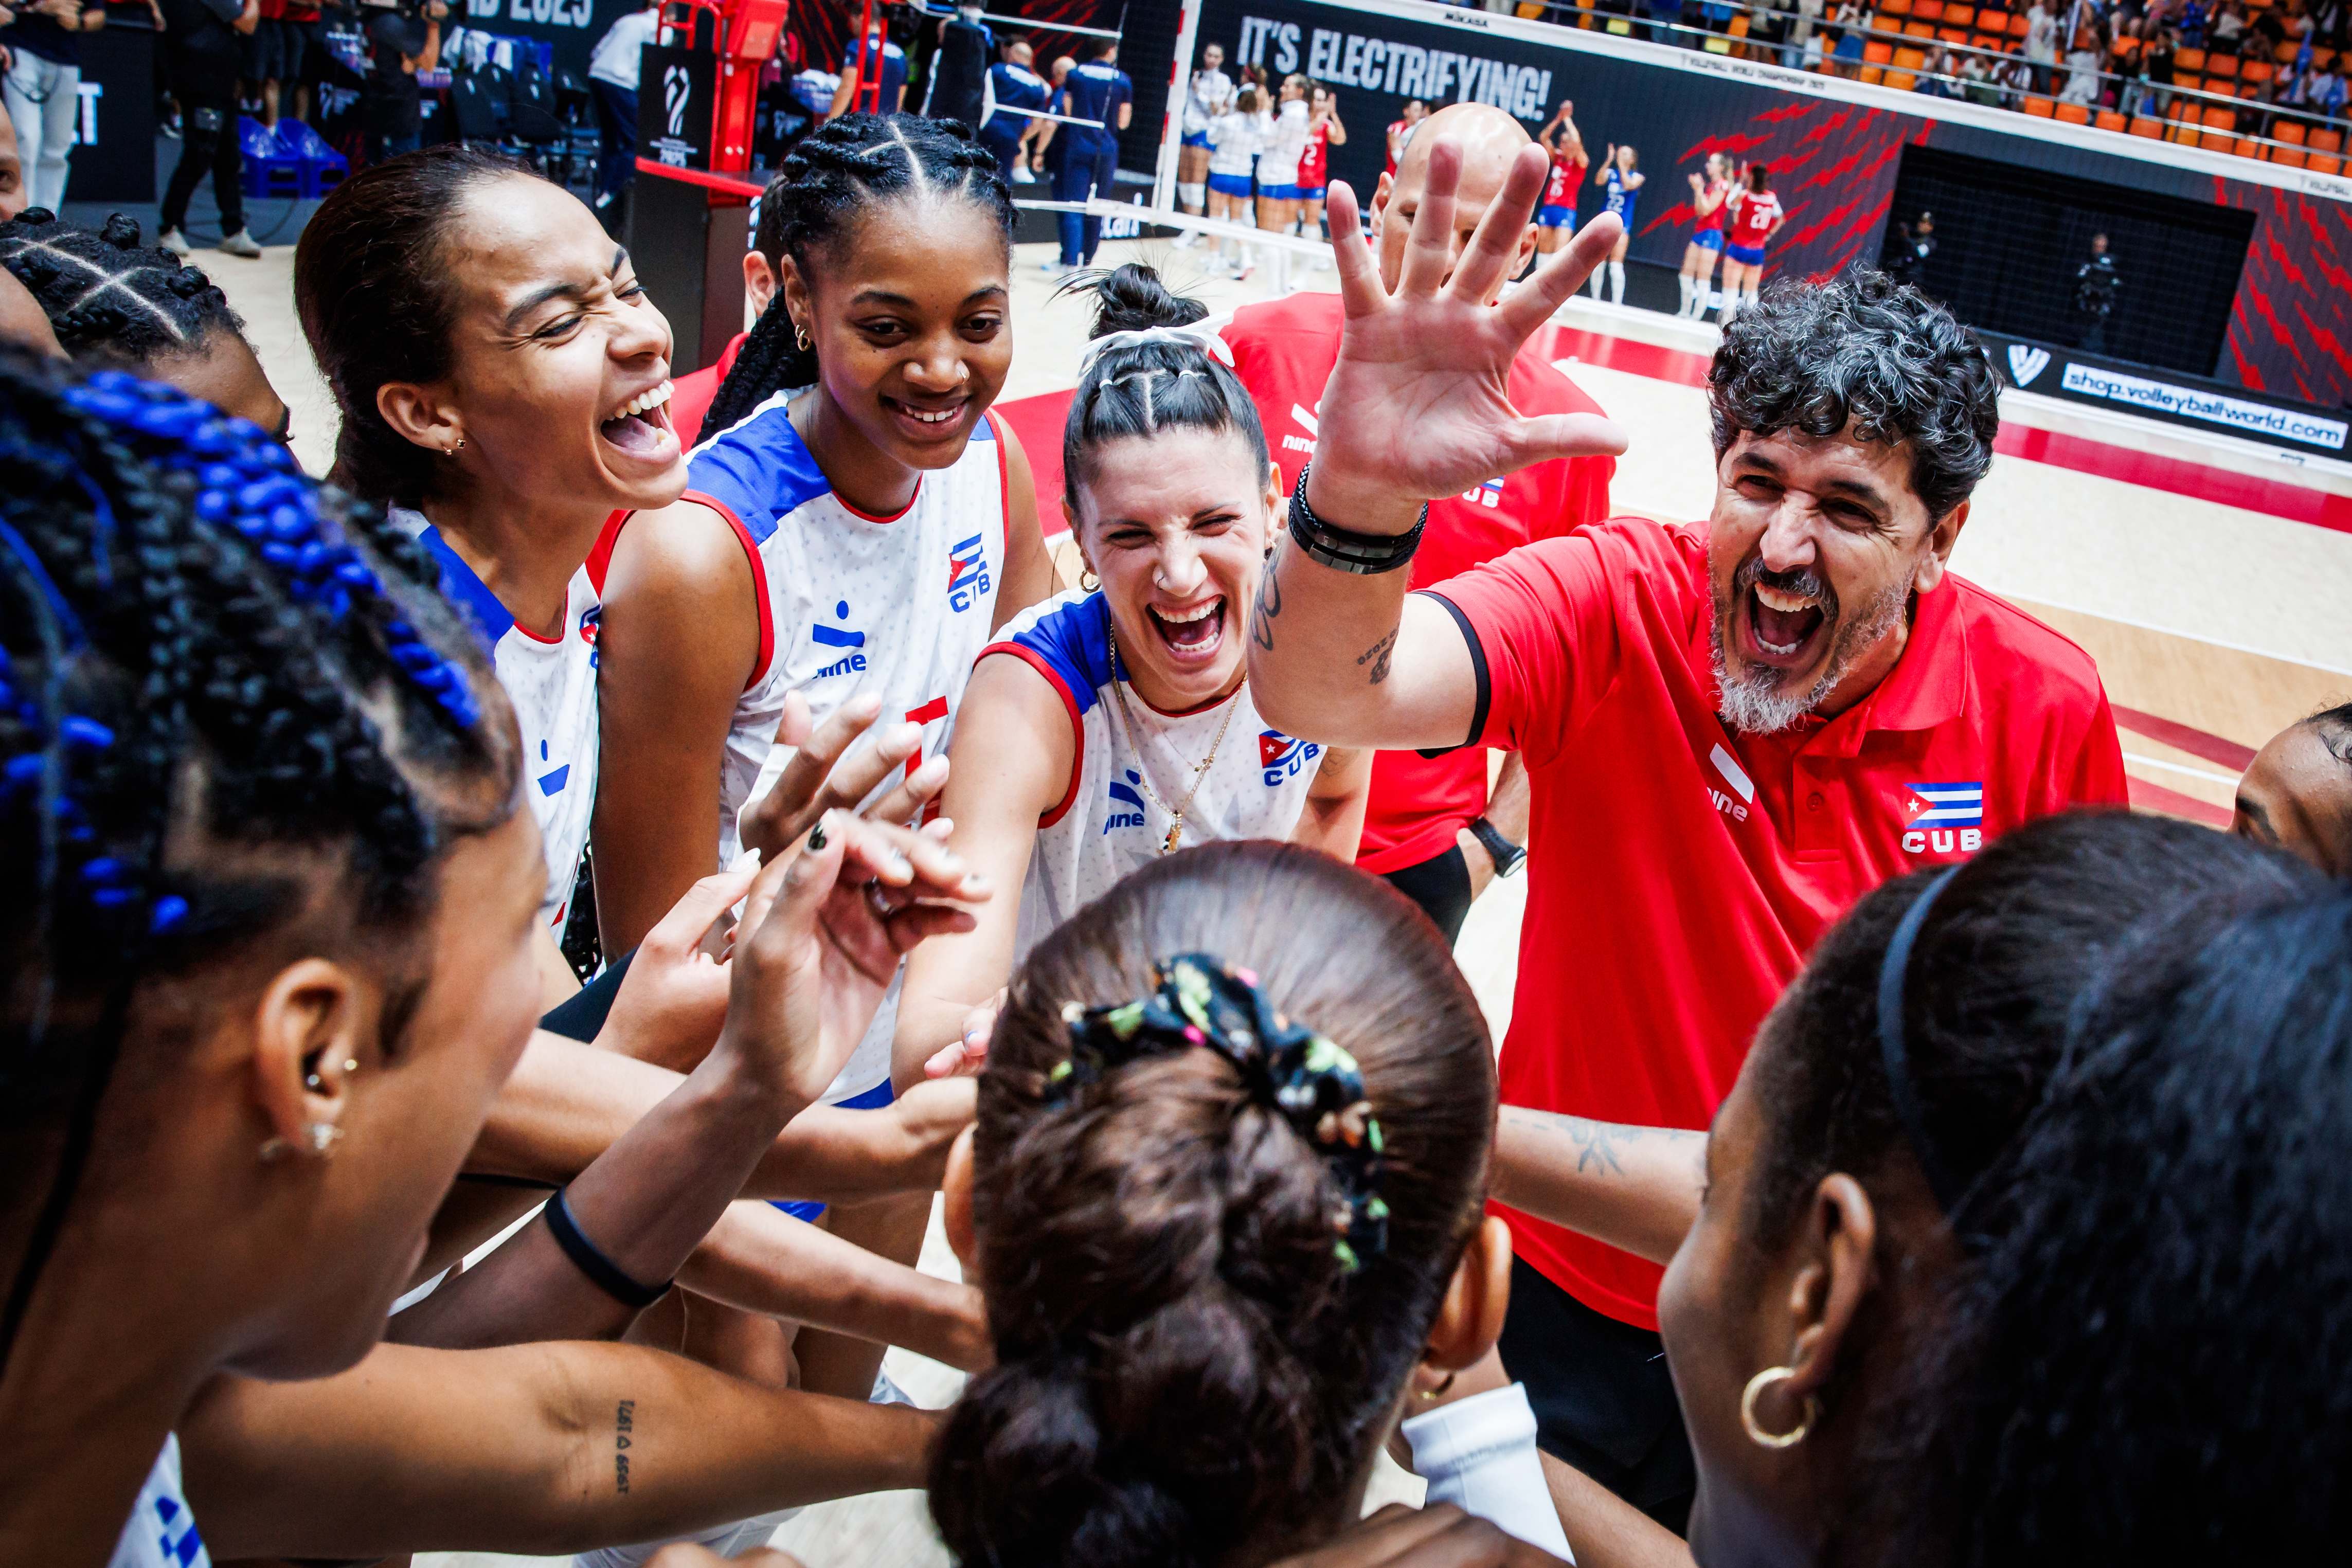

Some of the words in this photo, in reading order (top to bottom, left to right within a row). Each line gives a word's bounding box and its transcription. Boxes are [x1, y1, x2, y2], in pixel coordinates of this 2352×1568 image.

[1237, 16, 1302, 74] IT'S
[1307, 28, 1552, 121] ELECTRIFYING!
[1303, 145, 1317, 166] 2
[2069, 372, 2339, 443] shop.volleyballworld.com
[1462, 487, 1499, 508] UB
[950, 573, 990, 612] CB
[1264, 744, 1319, 786] CUB
[1707, 787, 1748, 822] ine
[1902, 828, 1982, 853] CUB
